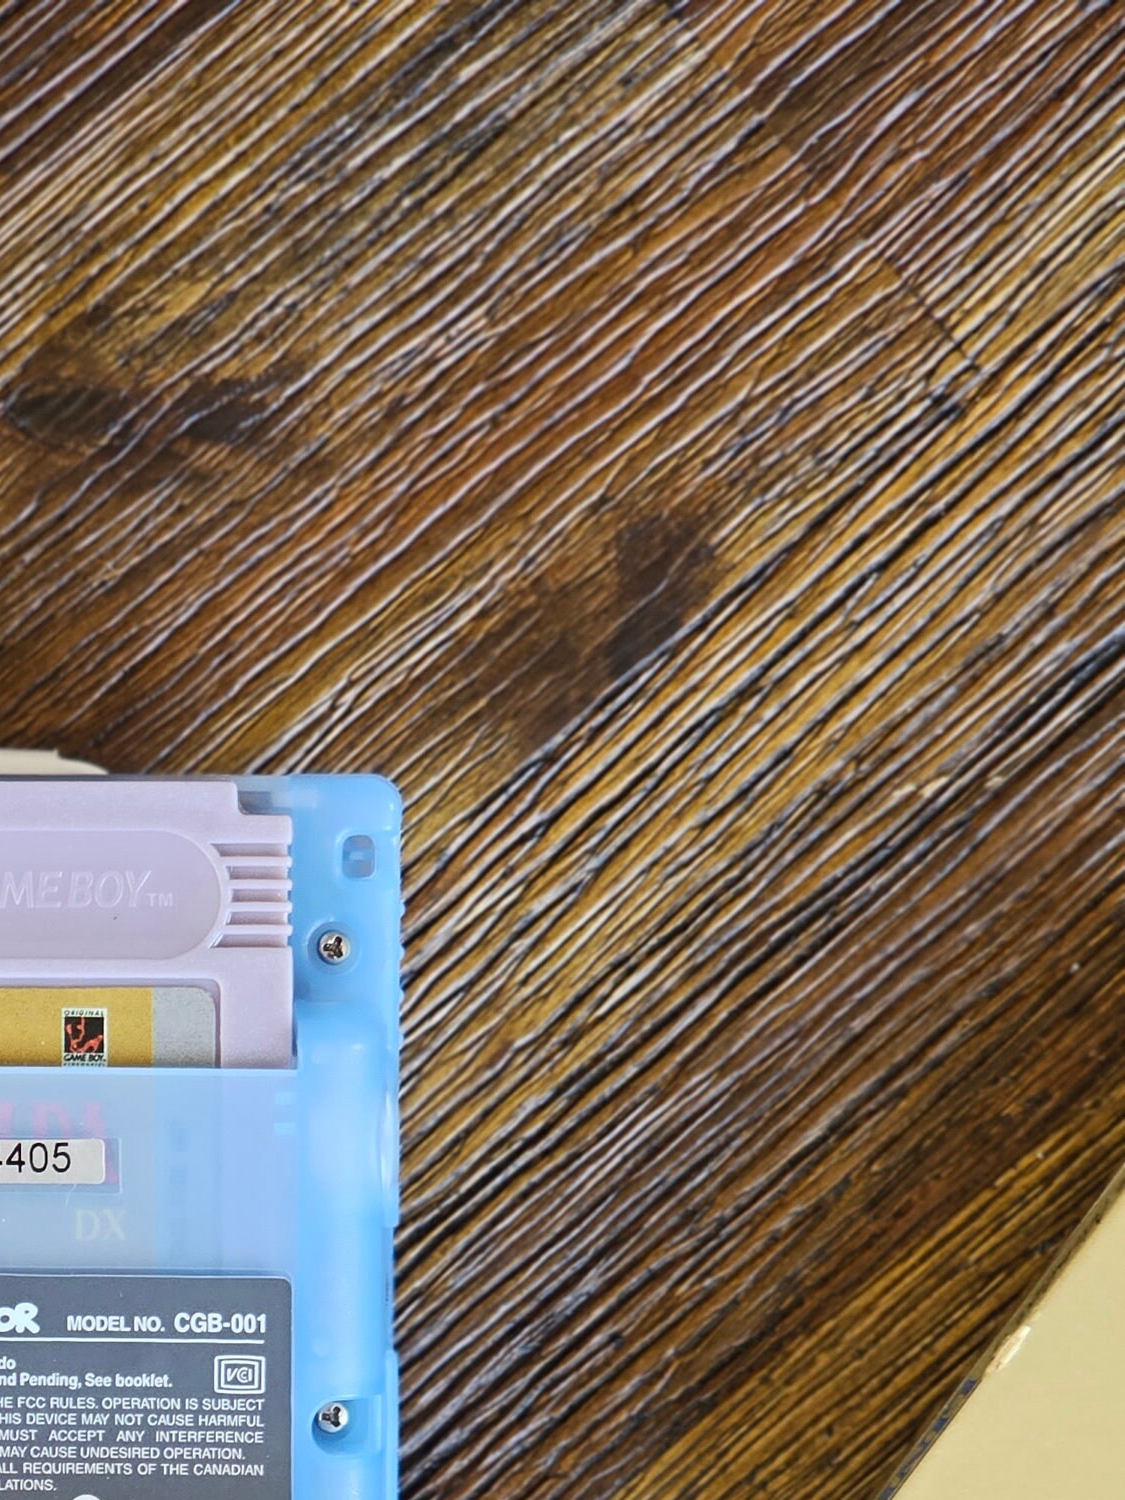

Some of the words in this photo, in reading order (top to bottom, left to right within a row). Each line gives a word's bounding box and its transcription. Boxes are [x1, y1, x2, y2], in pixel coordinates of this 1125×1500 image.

[64, 1009, 104, 1017] ORIGINAL
[64, 1053, 85, 1062] GAME
[75, 1208, 128, 1241] DX
[67, 1314, 131, 1332] MODEL
[133, 1315, 165, 1332] NO.
[174, 1311, 266, 1334] CGB-001
[19, 1371, 82, 1390] Pending,
[84, 1372, 112, 1387] See
[115, 1372, 172, 1388] booklet.
[17, 1395, 46, 1408] FCC
[50, 1396, 98, 1409] RULES.
[101, 1396, 180, 1410] OPERATION
[185, 1397, 198, 1410] IS
[202, 1398, 265, 1411] SUBJECT
[26, 1412, 77, 1425] DEVICE
[81, 1412, 110, 1425] MAY
[114, 1413, 144, 1425] NOT
[147, 1413, 194, 1426] CAUSE
[198, 1414, 264, 1427] HARMFUL
[48, 1429, 105, 1441] ACCEPT
[116, 1429, 145, 1442] ANY
[155, 1430, 263, 1443] INTERFERENCE
[30, 1445, 77, 1458] CAUSE
[80, 1446, 160, 1459] UNDESIRED
[163, 1446, 245, 1460] OPERATION.
[22, 1461, 132, 1475] REQUIREMENTS
[137, 1462, 157, 1475] OF
[160, 1463, 188, 1475] THE
[193, 1463, 264, 1476] CANADIAN
